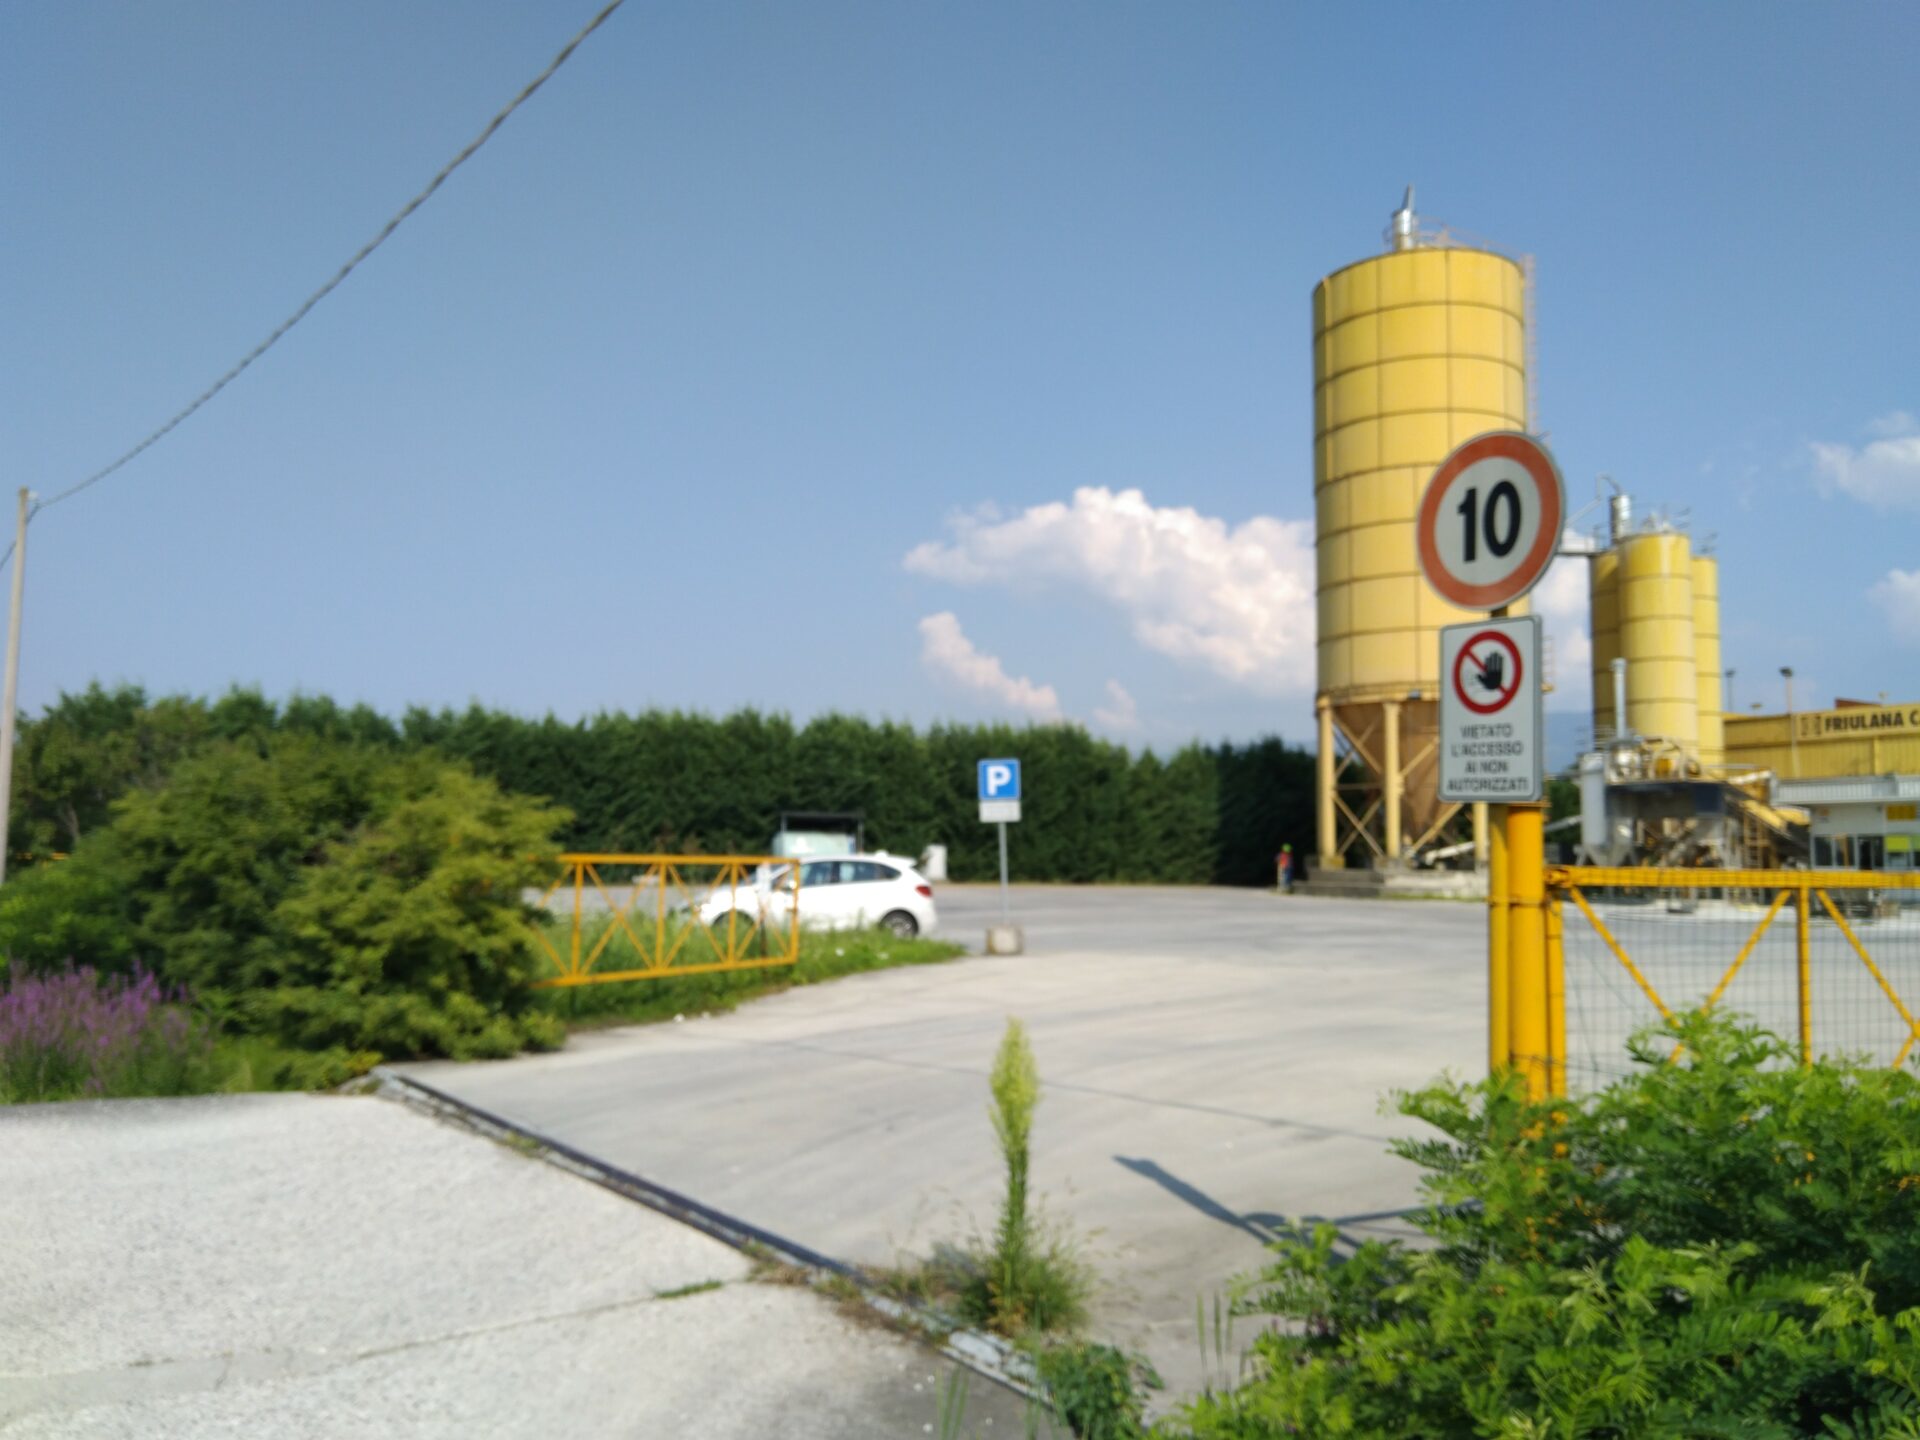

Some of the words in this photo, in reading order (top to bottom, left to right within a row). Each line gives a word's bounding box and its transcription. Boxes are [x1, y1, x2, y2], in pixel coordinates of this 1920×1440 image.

[1457, 480, 1522, 562] 10
[1825, 711, 1904, 731] FRIULANA
[1460, 723, 1513, 738] VIETATO
[1451, 740, 1523, 757] L'ACCESSO
[1465, 761, 1476, 773] AI
[1480, 760, 1508, 774] NON
[987, 765, 1012, 796] P
[1447, 776, 1528, 793] AUTORIZZATI
